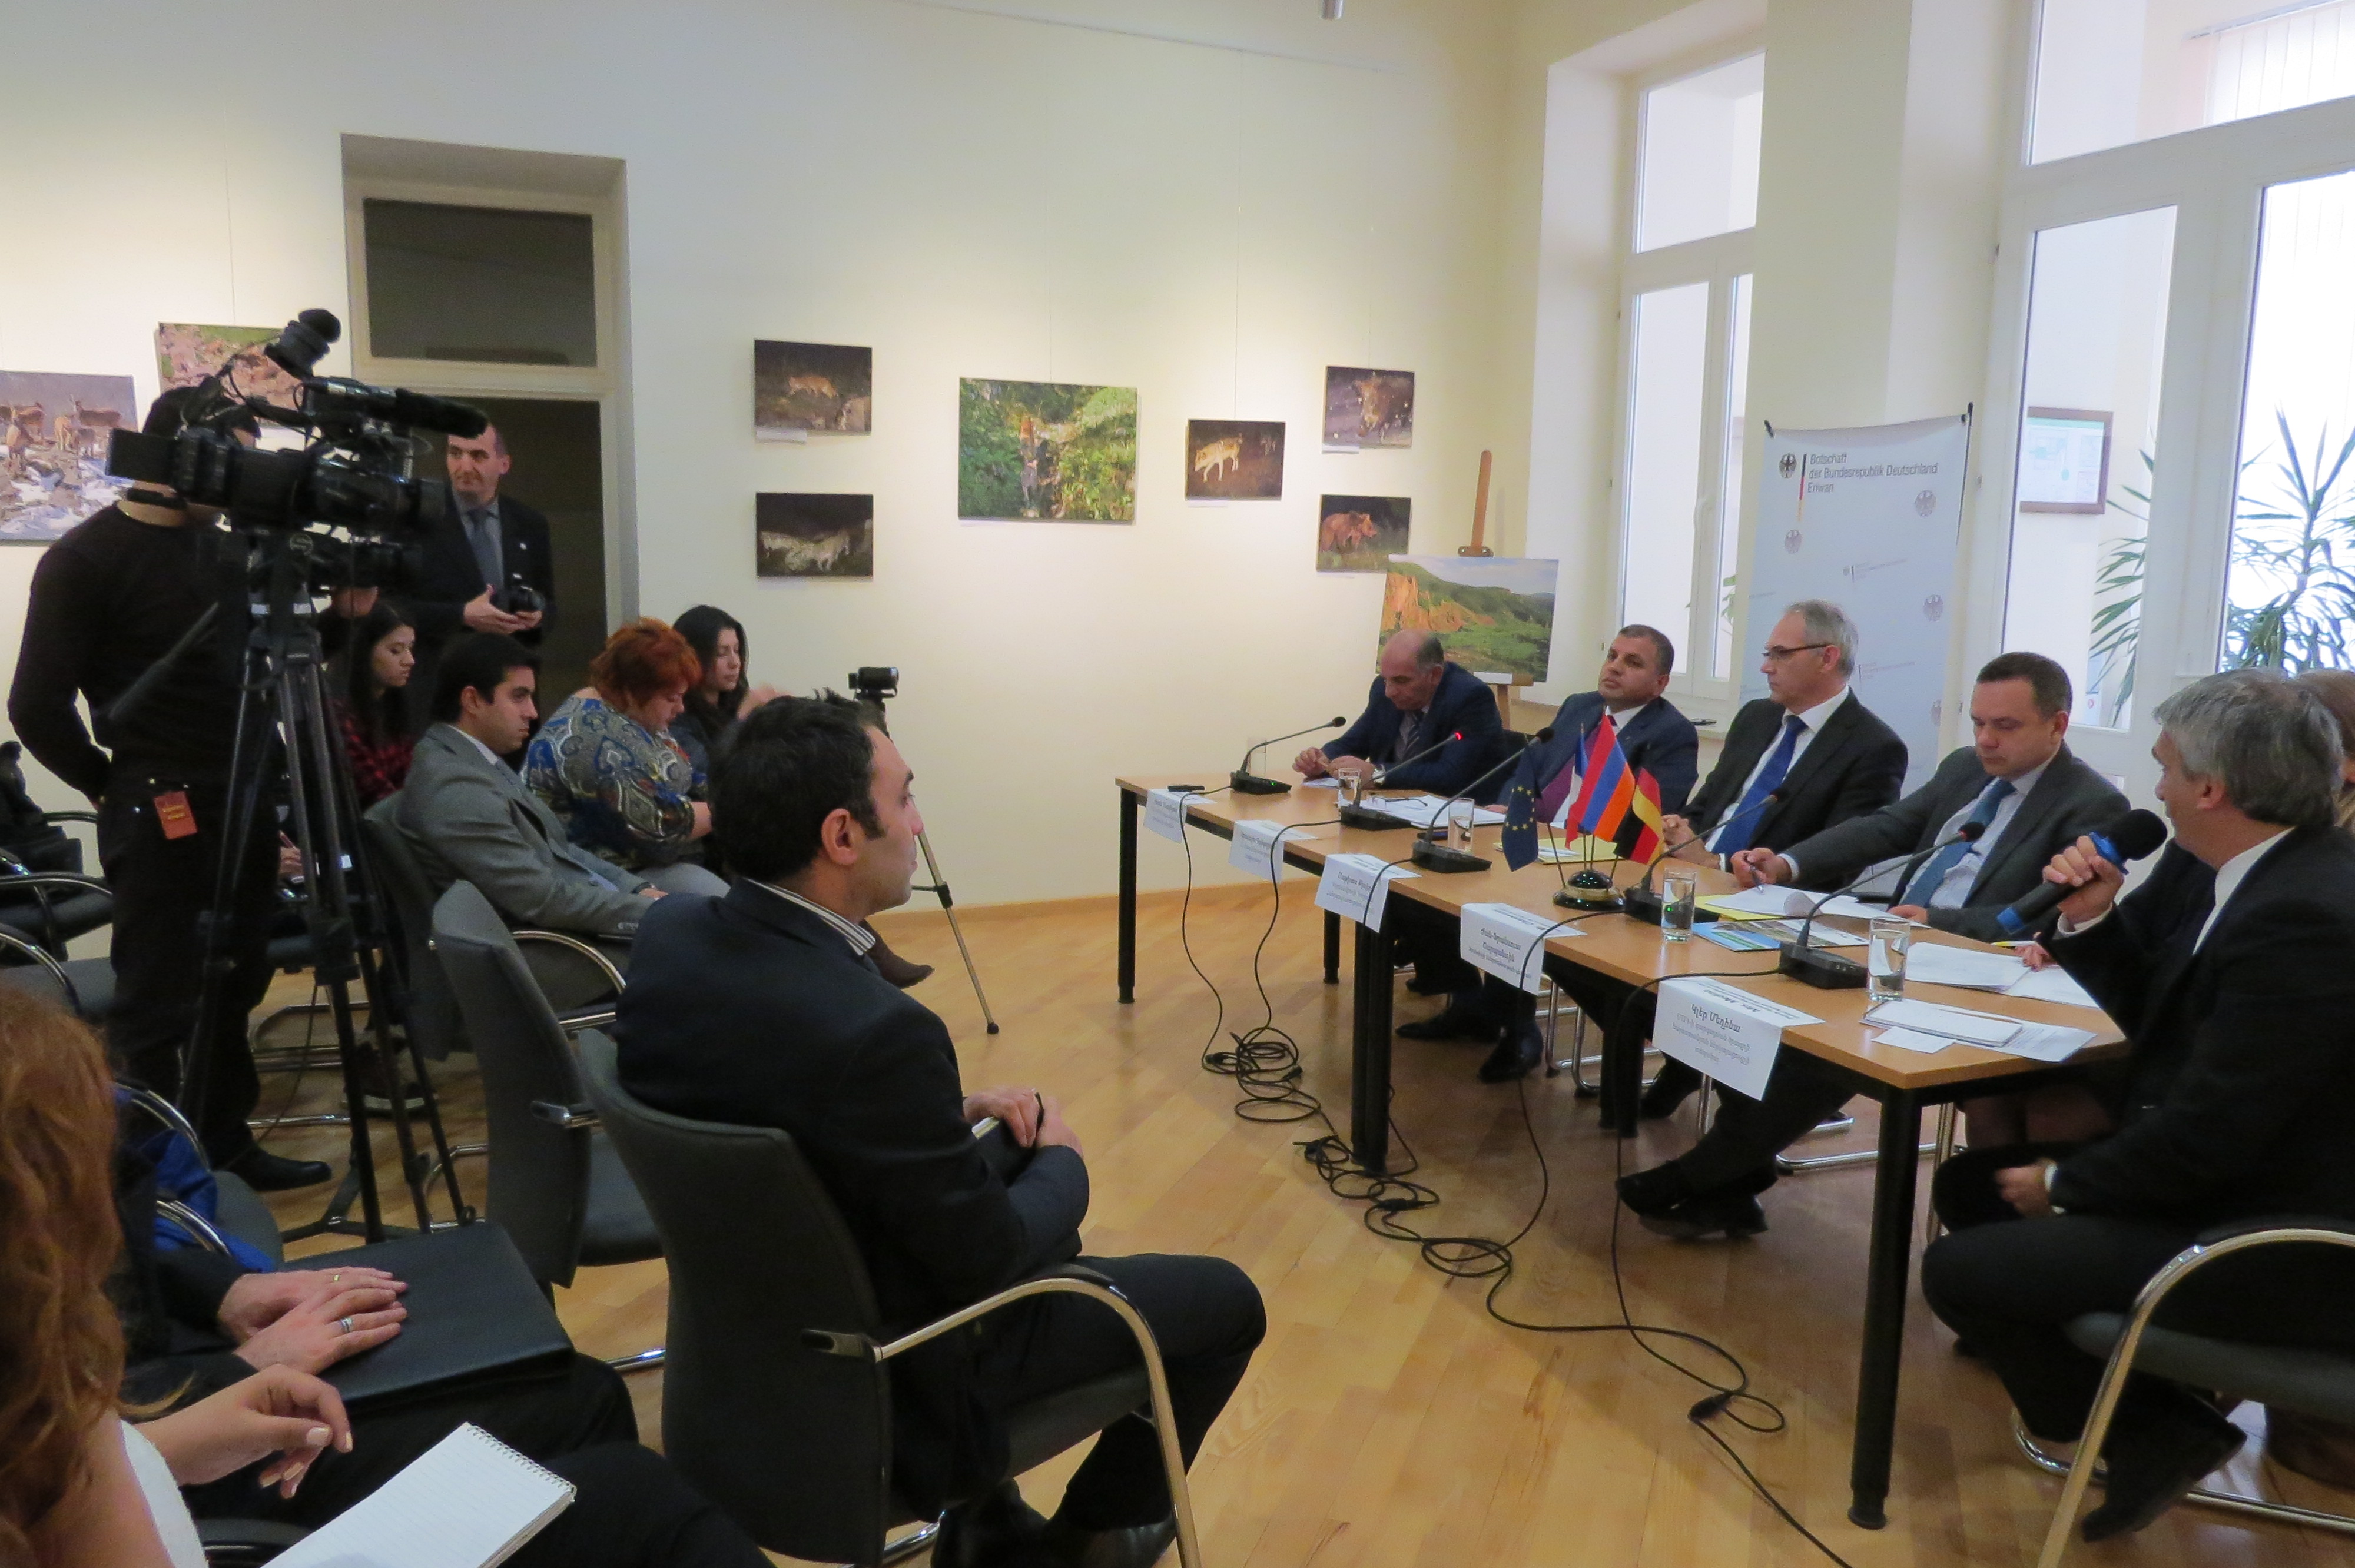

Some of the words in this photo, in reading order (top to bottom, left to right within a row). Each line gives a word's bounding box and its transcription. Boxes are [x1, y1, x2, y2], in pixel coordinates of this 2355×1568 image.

[1810, 453, 1847, 465] Botschaft
[1809, 469, 1822, 479] der
[1823, 466, 1884, 480] Bundesrepublik
[1886, 463, 1938, 476] Deutschland
[1807, 482, 1834, 493] Eriwan
